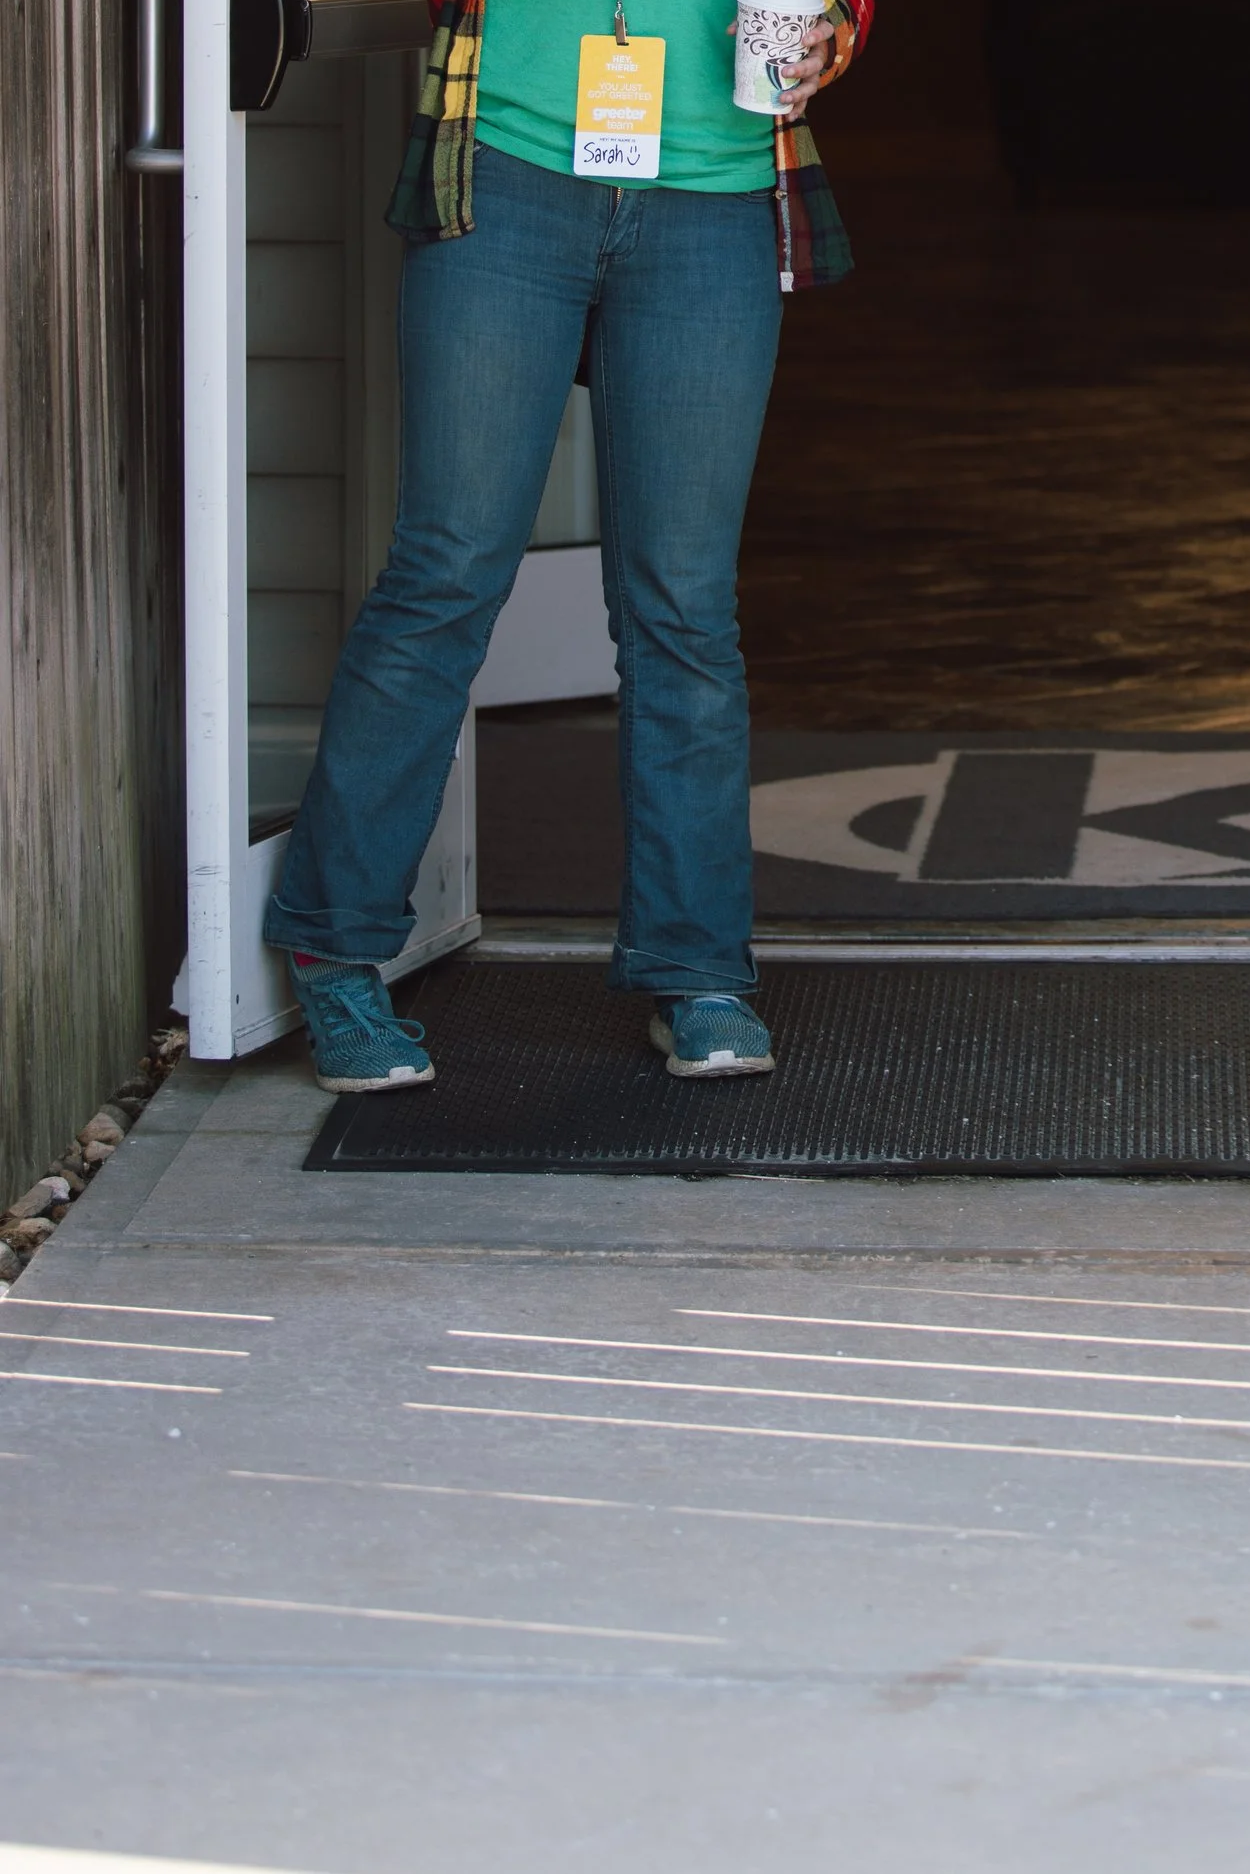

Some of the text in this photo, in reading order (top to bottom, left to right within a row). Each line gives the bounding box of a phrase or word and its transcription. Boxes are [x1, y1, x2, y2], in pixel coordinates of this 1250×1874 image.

[592, 106, 647, 121] greeter
[607, 119, 634, 131] team
[583, 141, 624, 164] Sarah
